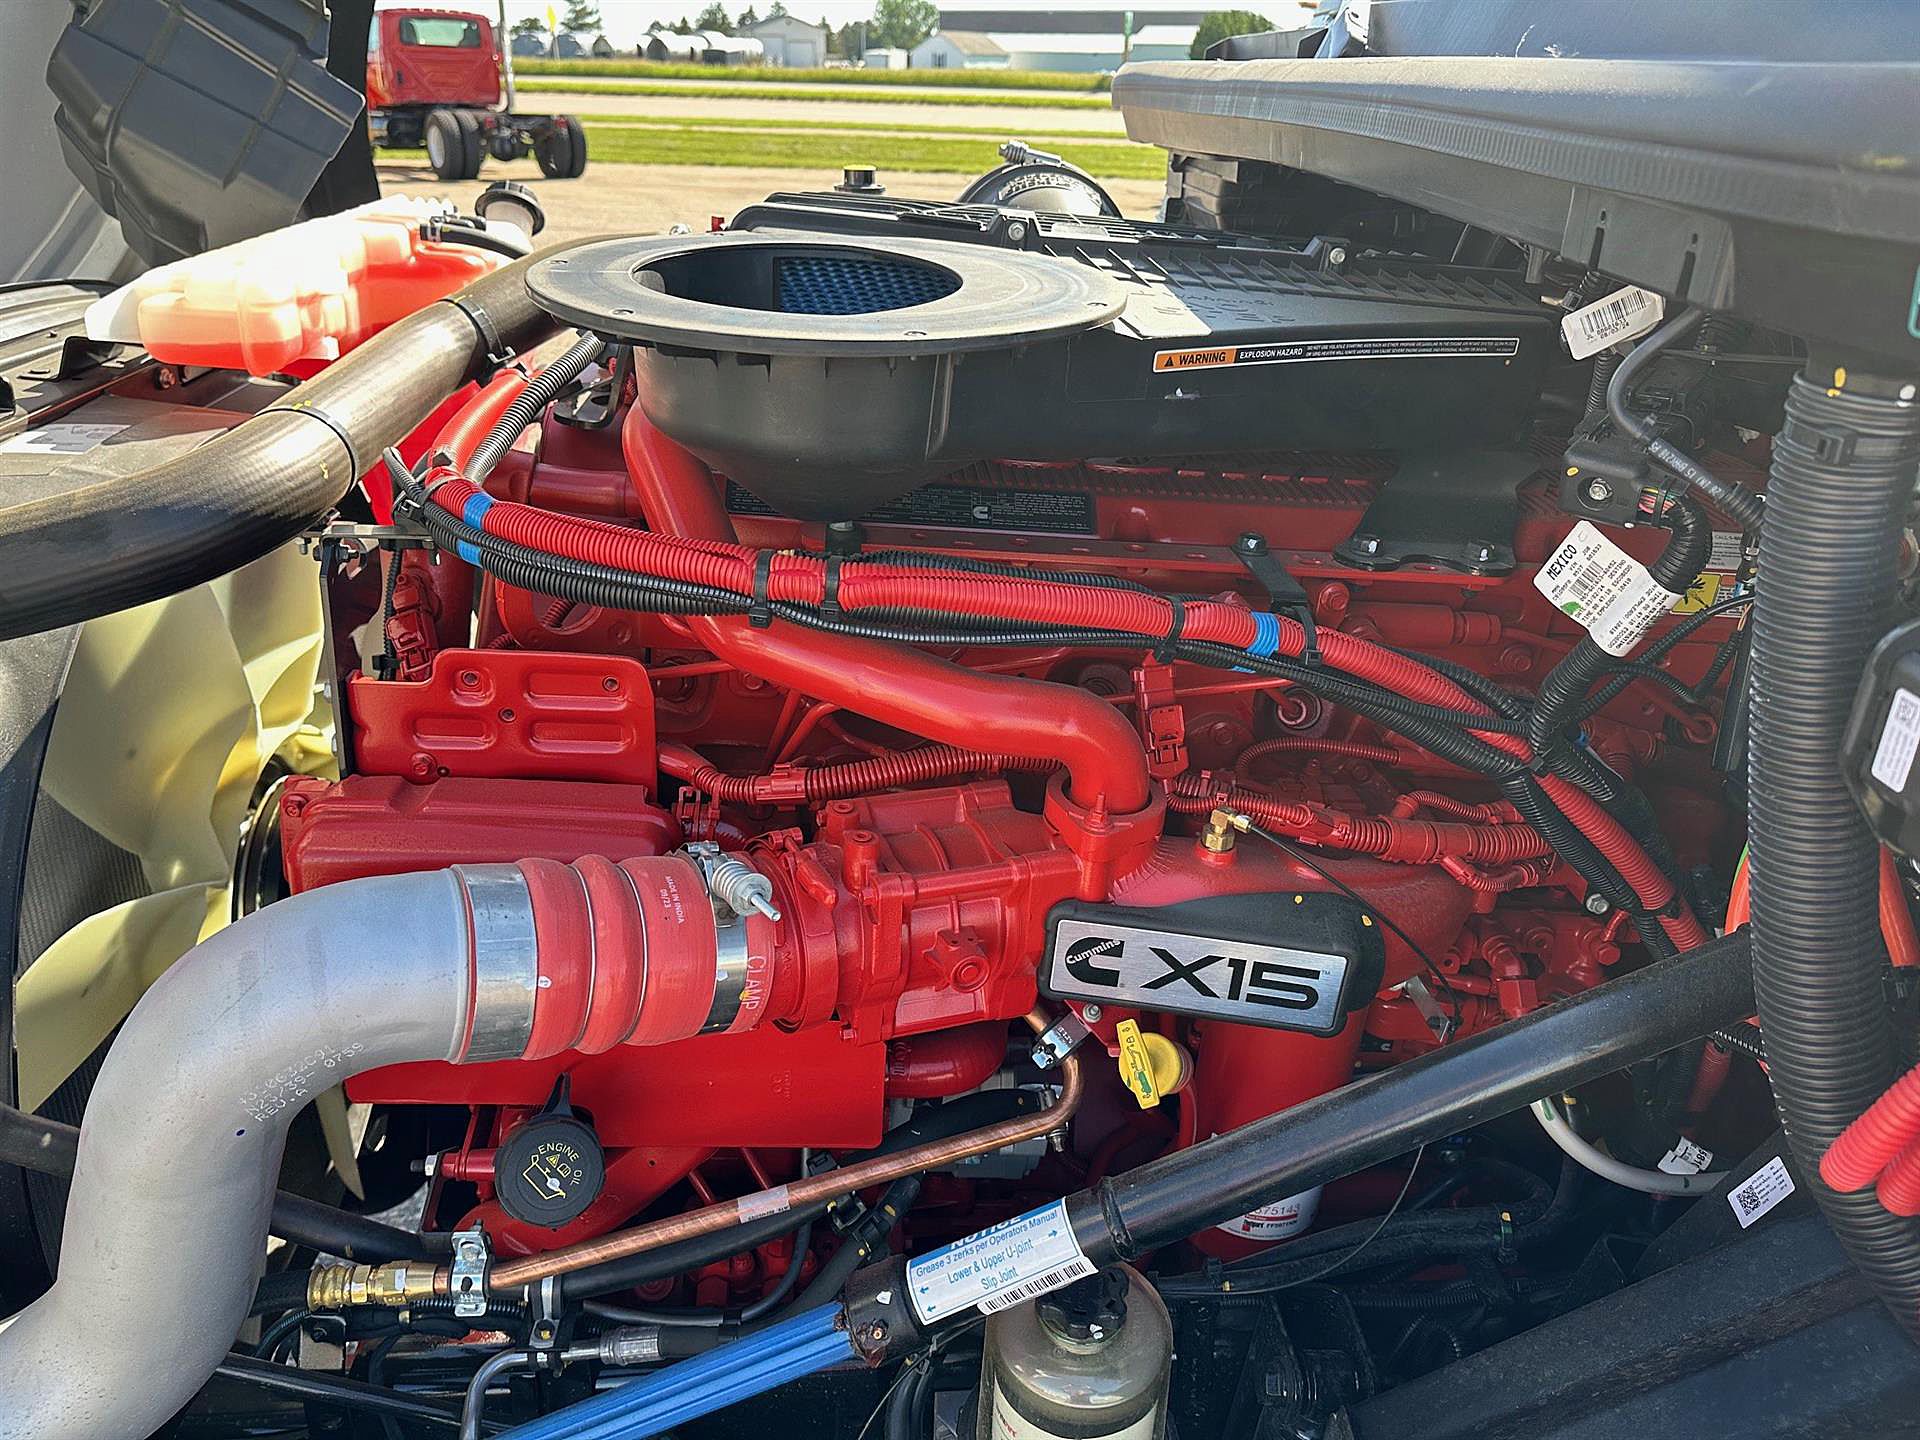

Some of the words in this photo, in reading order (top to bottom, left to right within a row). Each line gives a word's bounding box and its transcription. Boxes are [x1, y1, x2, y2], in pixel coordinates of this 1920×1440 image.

[1179, 351, 1226, 366] WARNING
[1239, 350, 1275, 360] EXPLOSION
[1276, 348, 1303, 357] HAZARD
[1546, 544, 1577, 580] MEXICO
[674, 902, 685, 924] INDIA
[1066, 938, 1121, 964] Cummins
[742, 956, 766, 1010] CLAMP
[1140, 947, 1321, 1010] X15
[537, 1142, 580, 1163] ENGINE
[569, 1169, 583, 1186] OIL
[916, 1260, 945, 1277] Grease
[946, 1256, 951, 1264] 3
[954, 1247, 975, 1263] zerks
[975, 1241, 988, 1255] per
[989, 1224, 1029, 1245] Operators
[1029, 1210, 1057, 1229] Manual
[947, 1269, 973, 1284] Lower
[973, 1261, 980, 1272] &
[982, 1251, 1006, 1270] Upper
[981, 1276, 999, 1290] Slip
[1000, 1266, 1019, 1282] Joint
